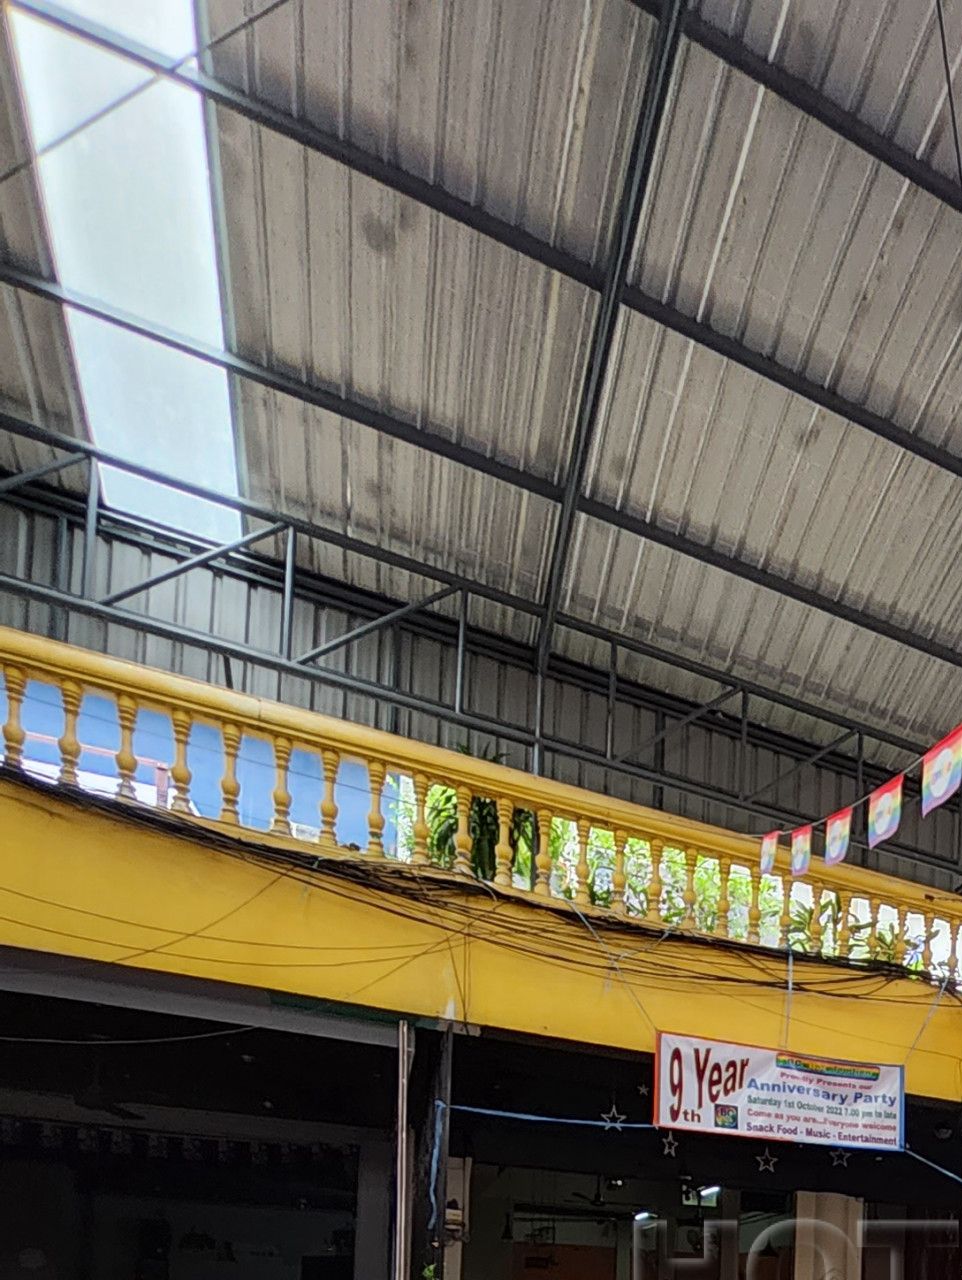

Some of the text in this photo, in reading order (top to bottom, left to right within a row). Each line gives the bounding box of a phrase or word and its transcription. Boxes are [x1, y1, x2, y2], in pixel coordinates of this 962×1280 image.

[670, 1047, 750, 1123] 9 Year
[747, 1078, 897, 1107] Anniversary Party
[816, 1078, 856, 1089] Presents
[747, 1095, 782, 1108] Saturday
[784, 1098, 795, 1107] 1st
[797, 1102, 824, 1112] October
[683, 1110, 701, 1123] th
[747, 1109, 772, 1118] Come
[785, 1114, 801, 1122] you
[862, 1121, 897, 1131] welcome
[746, 1122, 774, 1133] Snack
[777, 1125, 798, 1135] Food
[805, 1128, 831, 1139] Music
[838, 1132, 897, 1146] Entertainment
